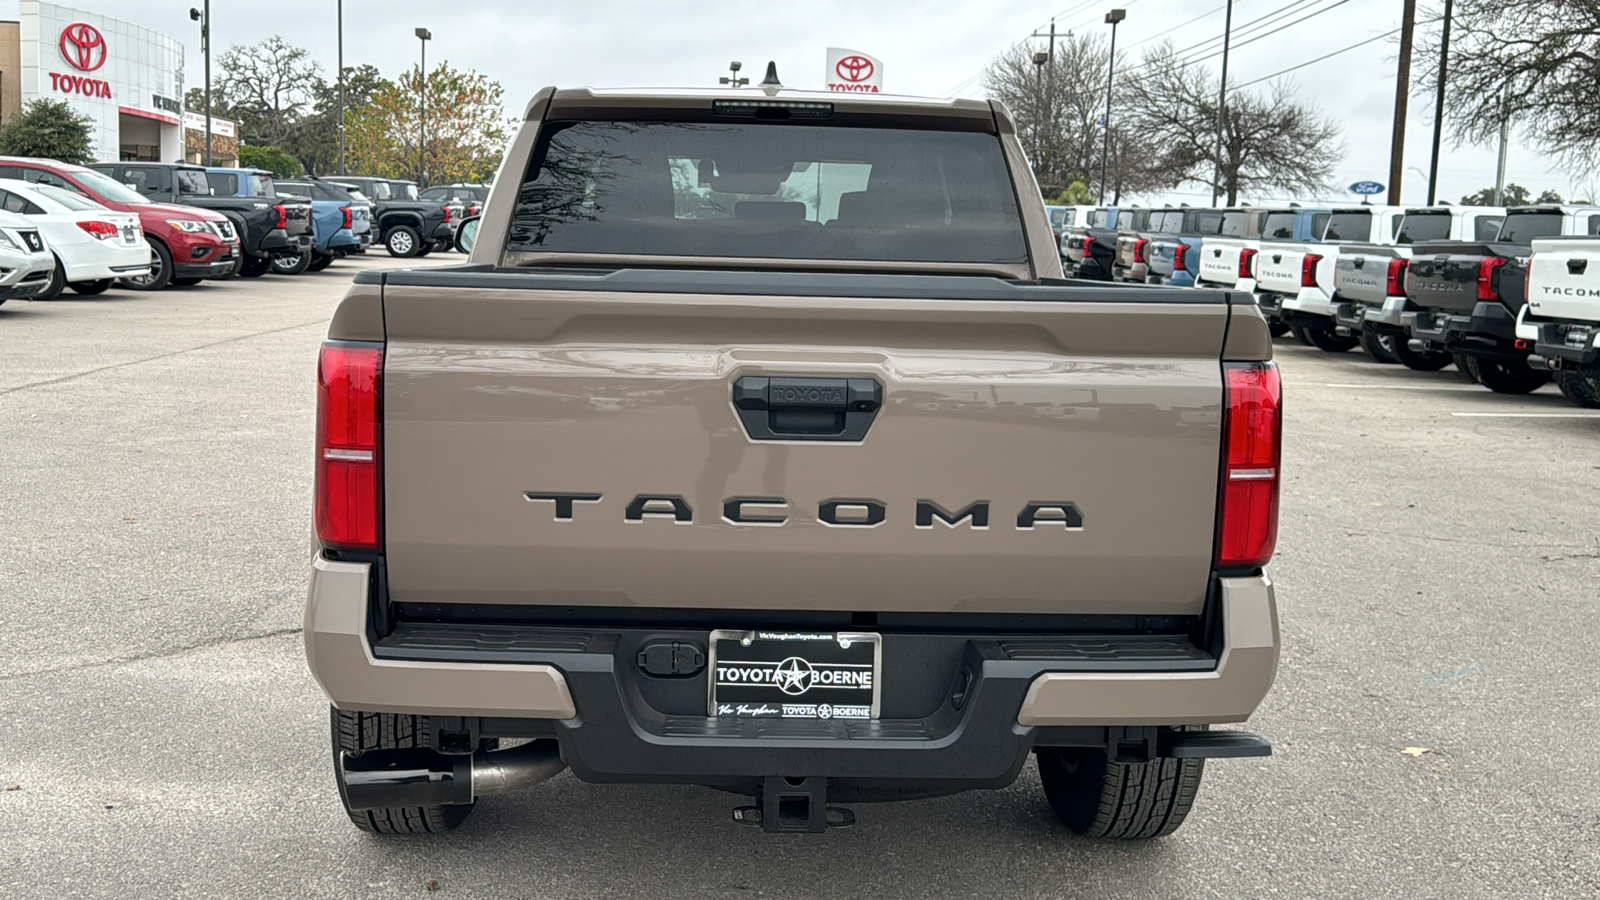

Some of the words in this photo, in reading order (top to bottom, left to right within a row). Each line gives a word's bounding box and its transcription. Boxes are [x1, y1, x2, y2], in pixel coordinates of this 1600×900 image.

[49, 72, 112, 99] TOYOTA
[828, 83, 879, 92] TOYOTA
[1355, 183, 1379, 193] Ford
[1205, 263, 1232, 271] TACOMA
[1262, 271, 1293, 279] TACOMA
[1341, 277, 1377, 287] TACOMA
[1542, 286, 1600, 298] TACOM
[773, 387, 843, 403] TOYOTA
[523, 491, 1085, 533] TACOMA
[759, 632, 833, 641] VicVaughanToyota.com
[716, 667, 784, 683] TOYOTA
[811, 670, 873, 685] BOERNE
[781, 706, 817, 715] TOYOTA
[832, 707, 870, 717] BOERNE
